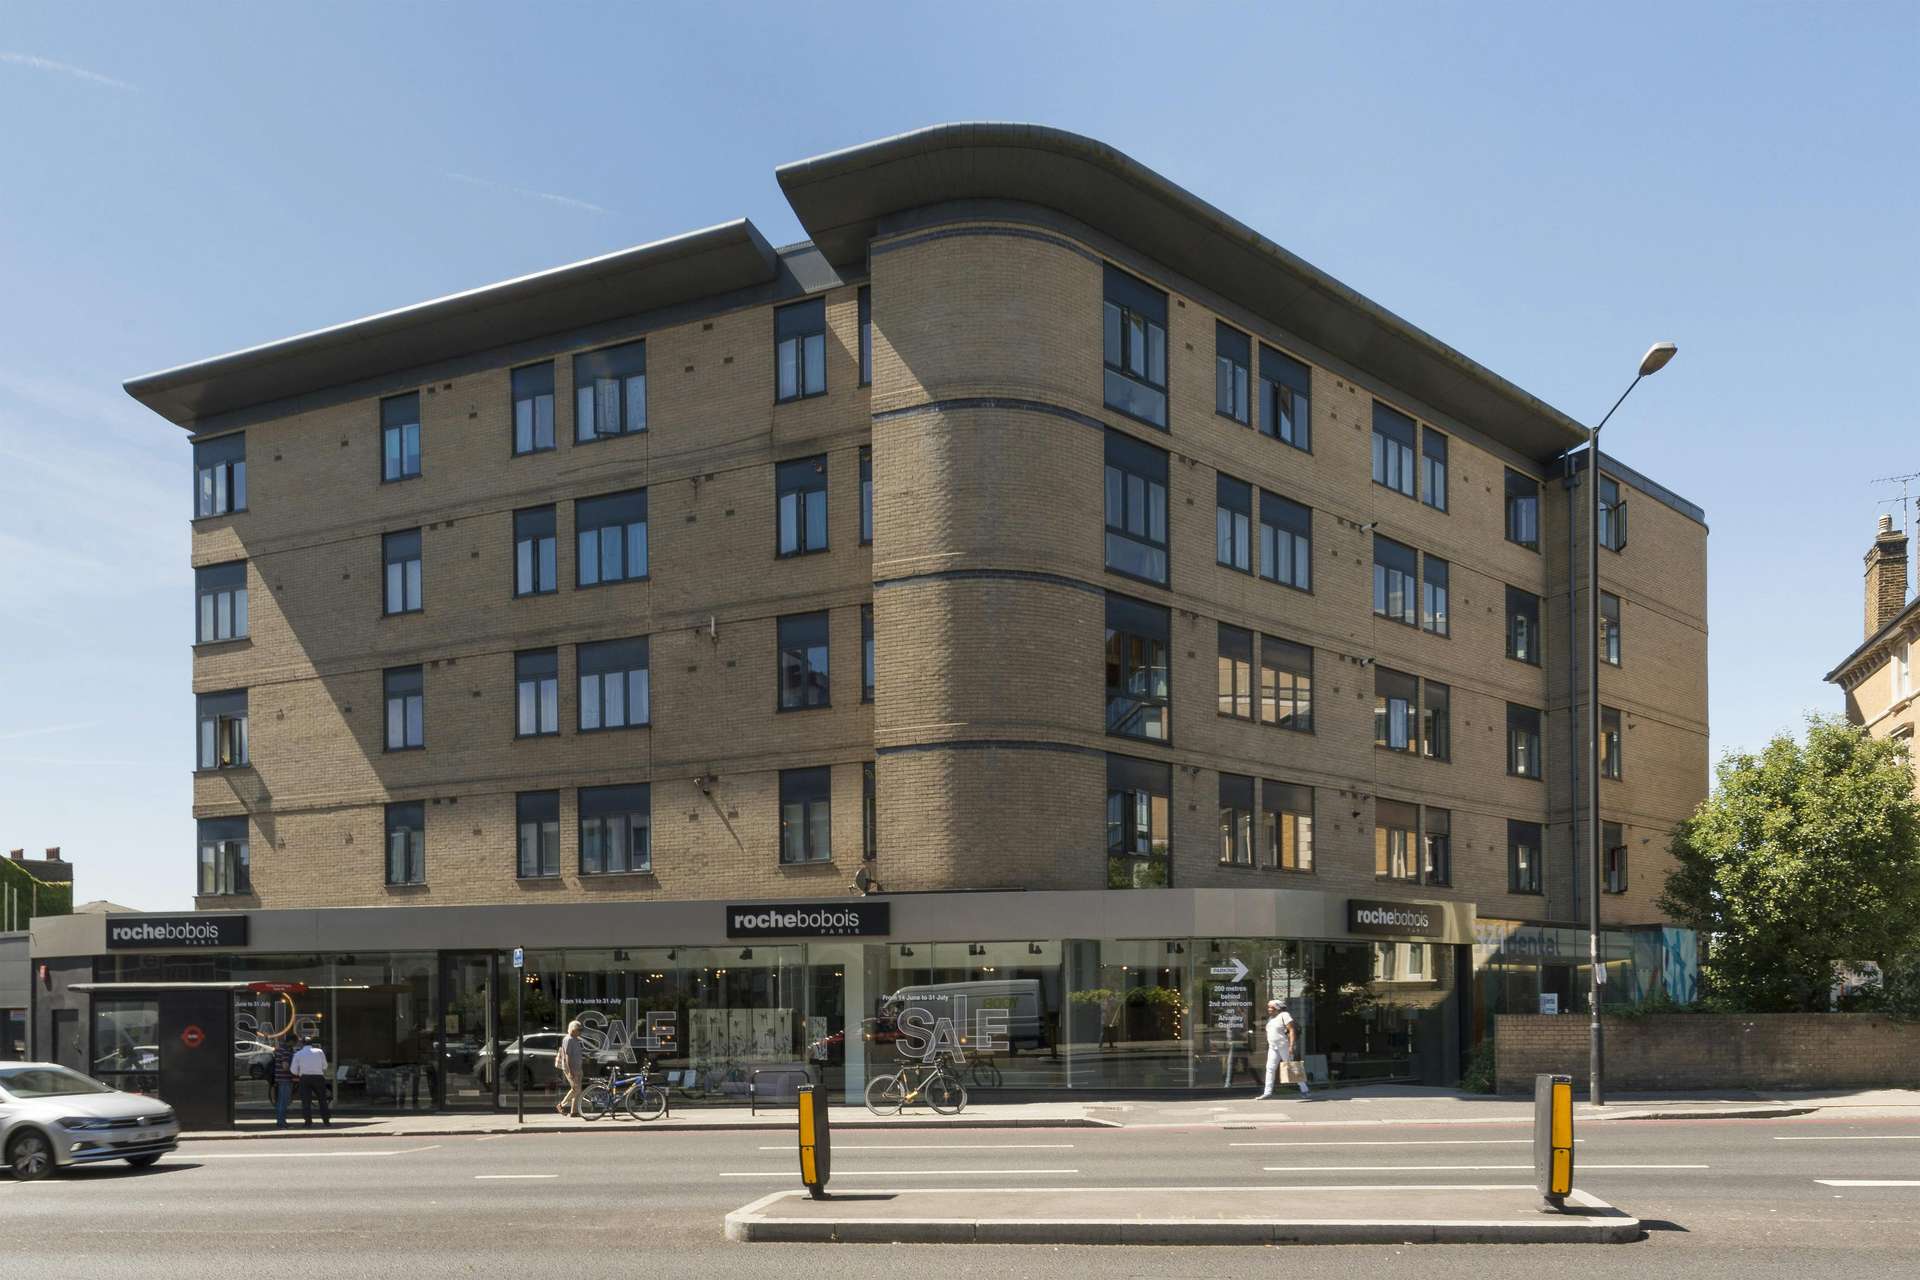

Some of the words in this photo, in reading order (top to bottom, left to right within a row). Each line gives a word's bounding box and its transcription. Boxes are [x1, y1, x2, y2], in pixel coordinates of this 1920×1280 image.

[734, 909, 860, 929] rochebobois
[1356, 907, 1430, 928] rochebobois
[112, 922, 219, 940] rochebobois
[576, 998, 678, 1064] SALE
[896, 994, 1010, 1064] SALE
